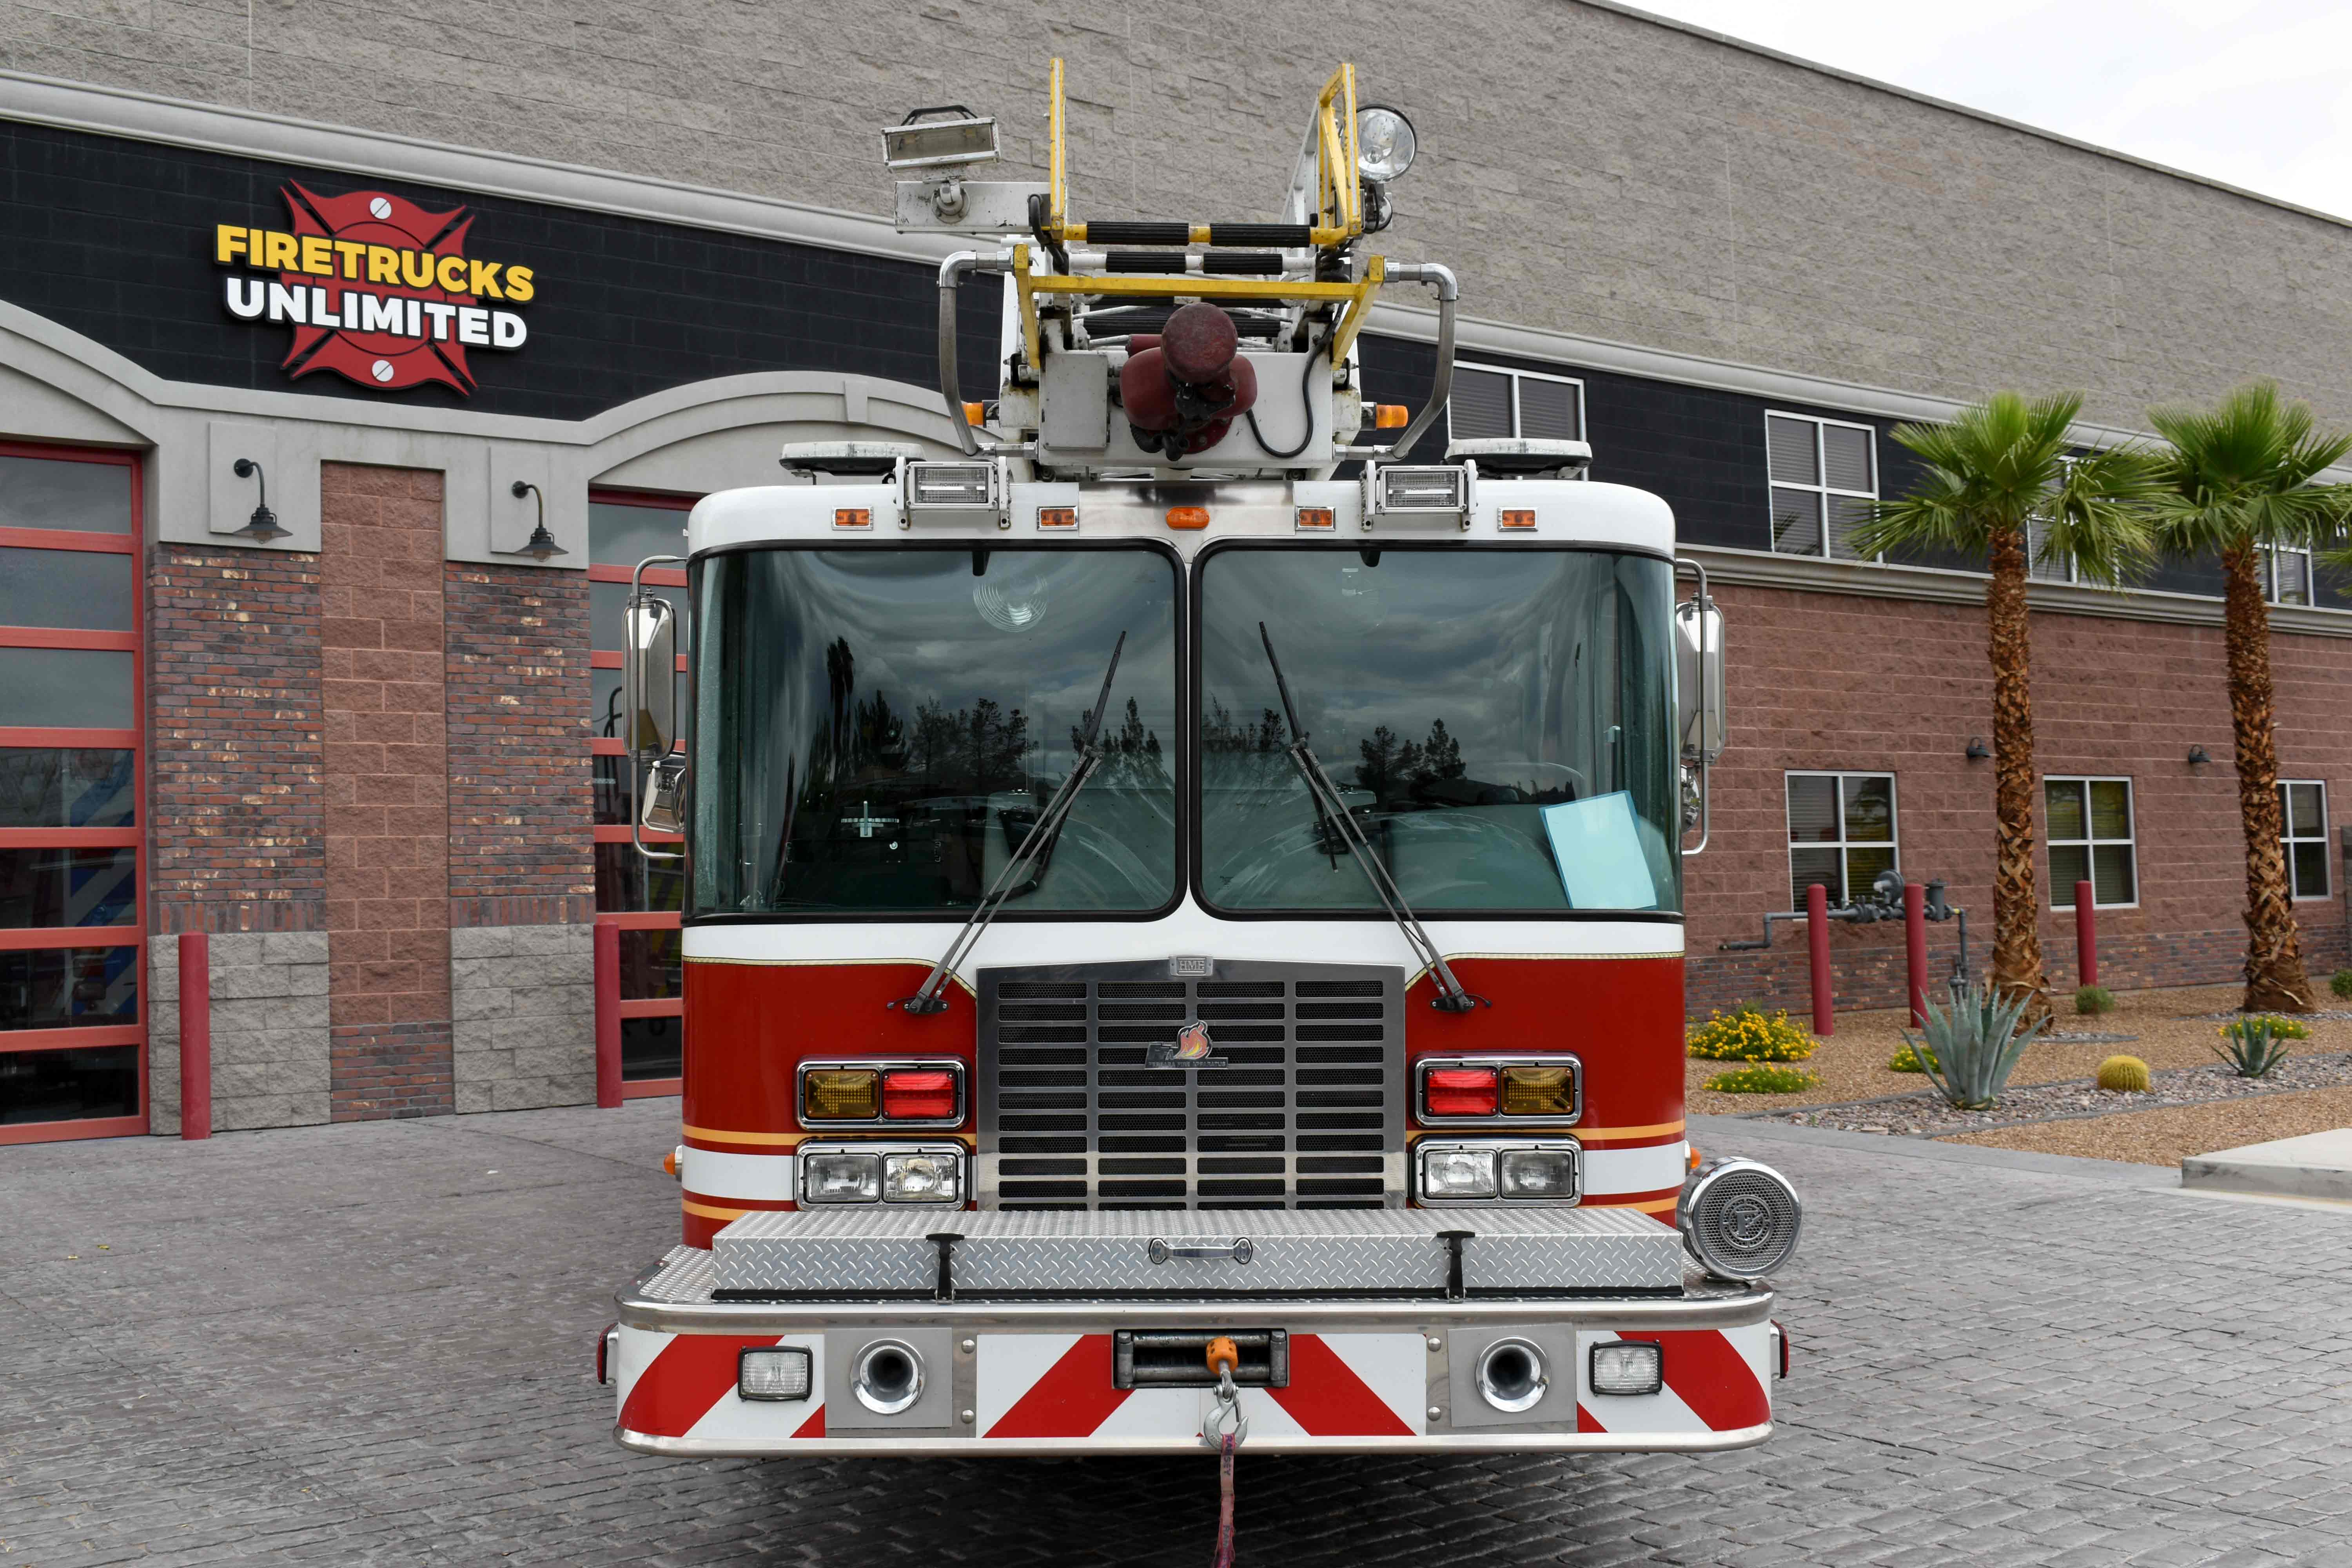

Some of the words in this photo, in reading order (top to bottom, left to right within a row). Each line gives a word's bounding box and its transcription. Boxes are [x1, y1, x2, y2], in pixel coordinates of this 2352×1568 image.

[217, 224, 534, 301] FIRETRUCKS
[227, 277, 527, 348] UNLIMITED
[1179, 960, 1205, 970] HME
